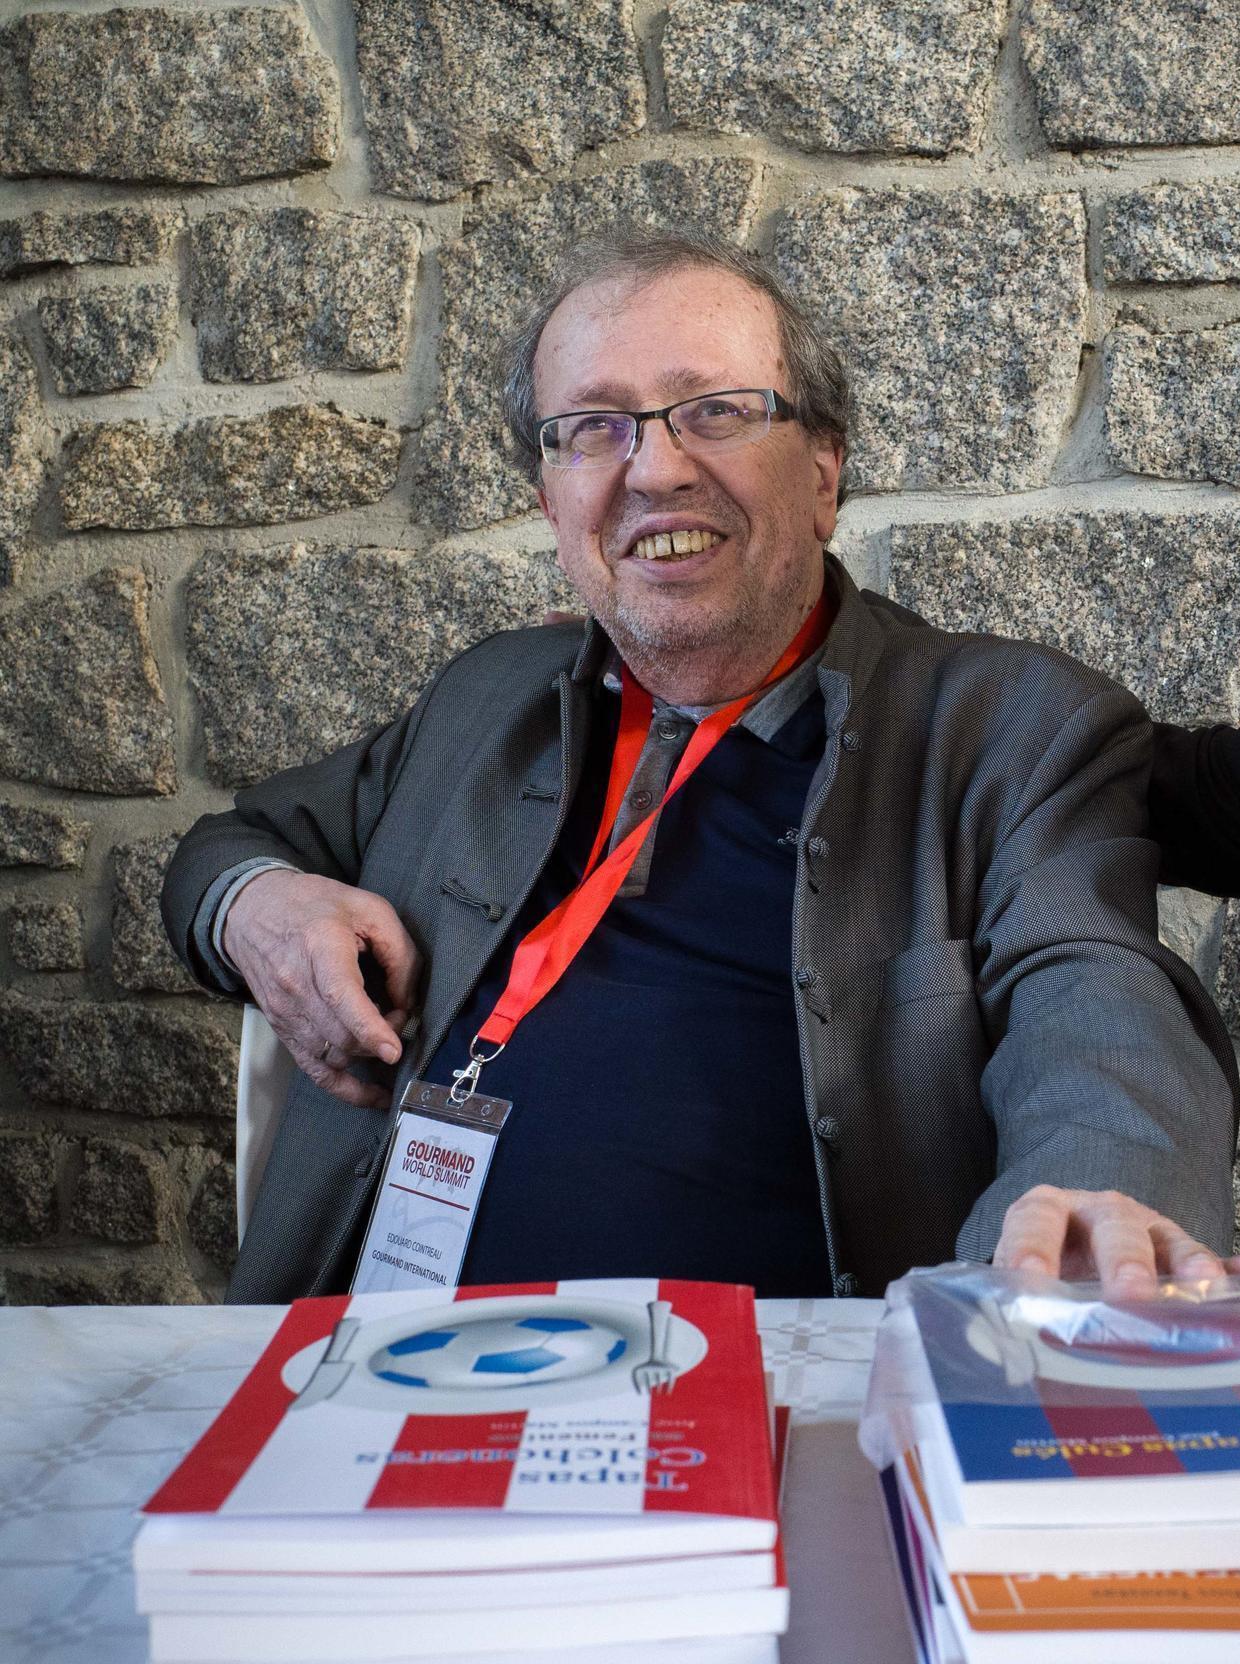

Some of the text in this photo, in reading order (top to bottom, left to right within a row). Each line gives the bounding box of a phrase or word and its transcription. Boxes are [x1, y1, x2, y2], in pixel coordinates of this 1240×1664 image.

[407, 1140, 476, 1174] GOURMAND
[402, 1157, 471, 1190] WORLD SUMMIT
[387, 1232, 442, 1260] EDOUARD COINTREAU
[371, 1250, 447, 1286] GOURMAND INTERNATIONAL
[355, 1447, 706, 1467] Colchoneras
[519, 1468, 688, 1491] Tapas
